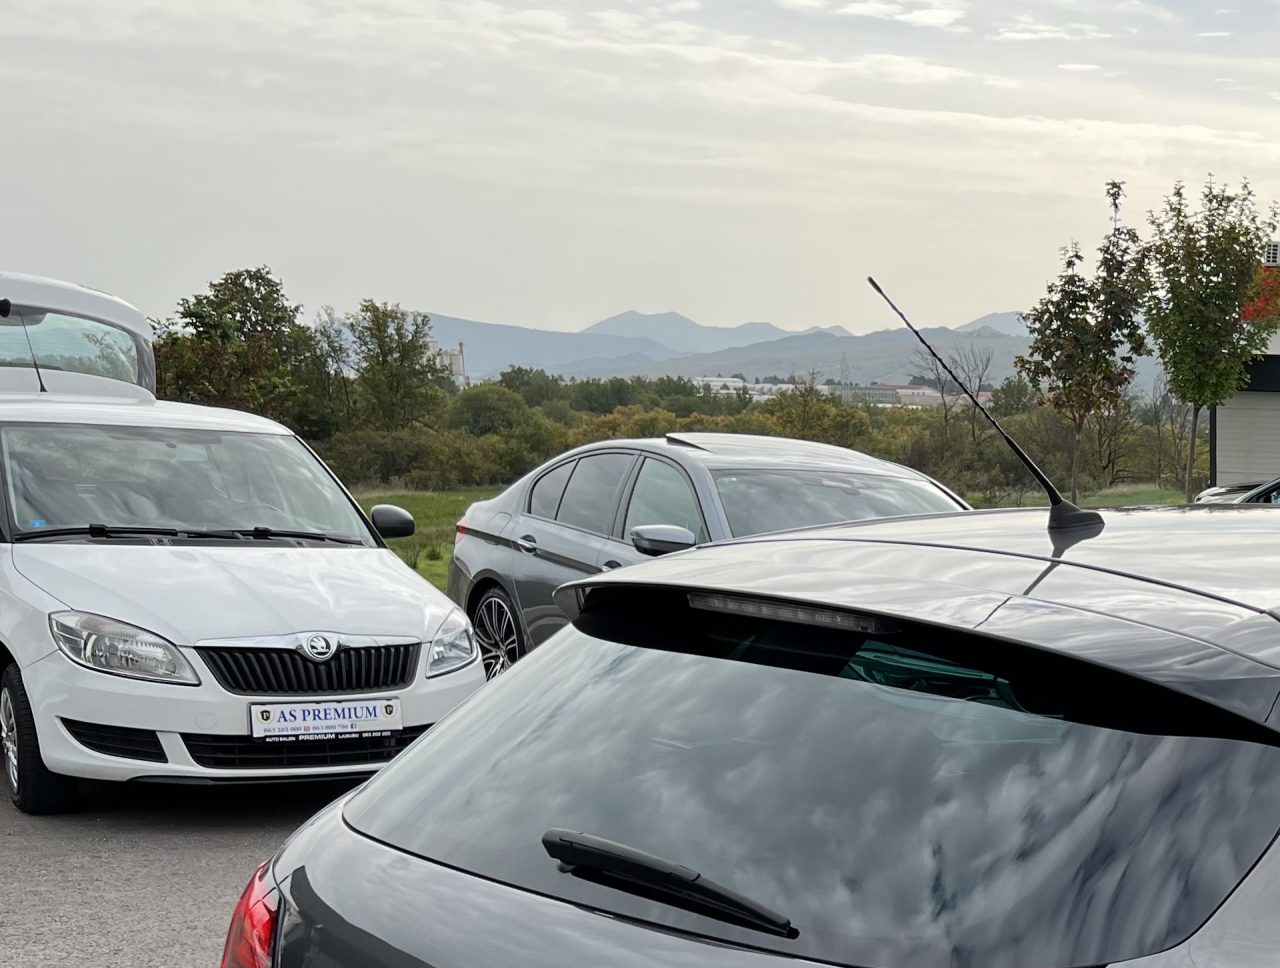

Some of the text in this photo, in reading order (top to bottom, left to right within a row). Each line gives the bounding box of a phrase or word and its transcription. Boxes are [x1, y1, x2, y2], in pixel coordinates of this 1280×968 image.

[278, 705, 378, 723] AS PREMIUM
[298, 733, 336, 741] PREMIUM
